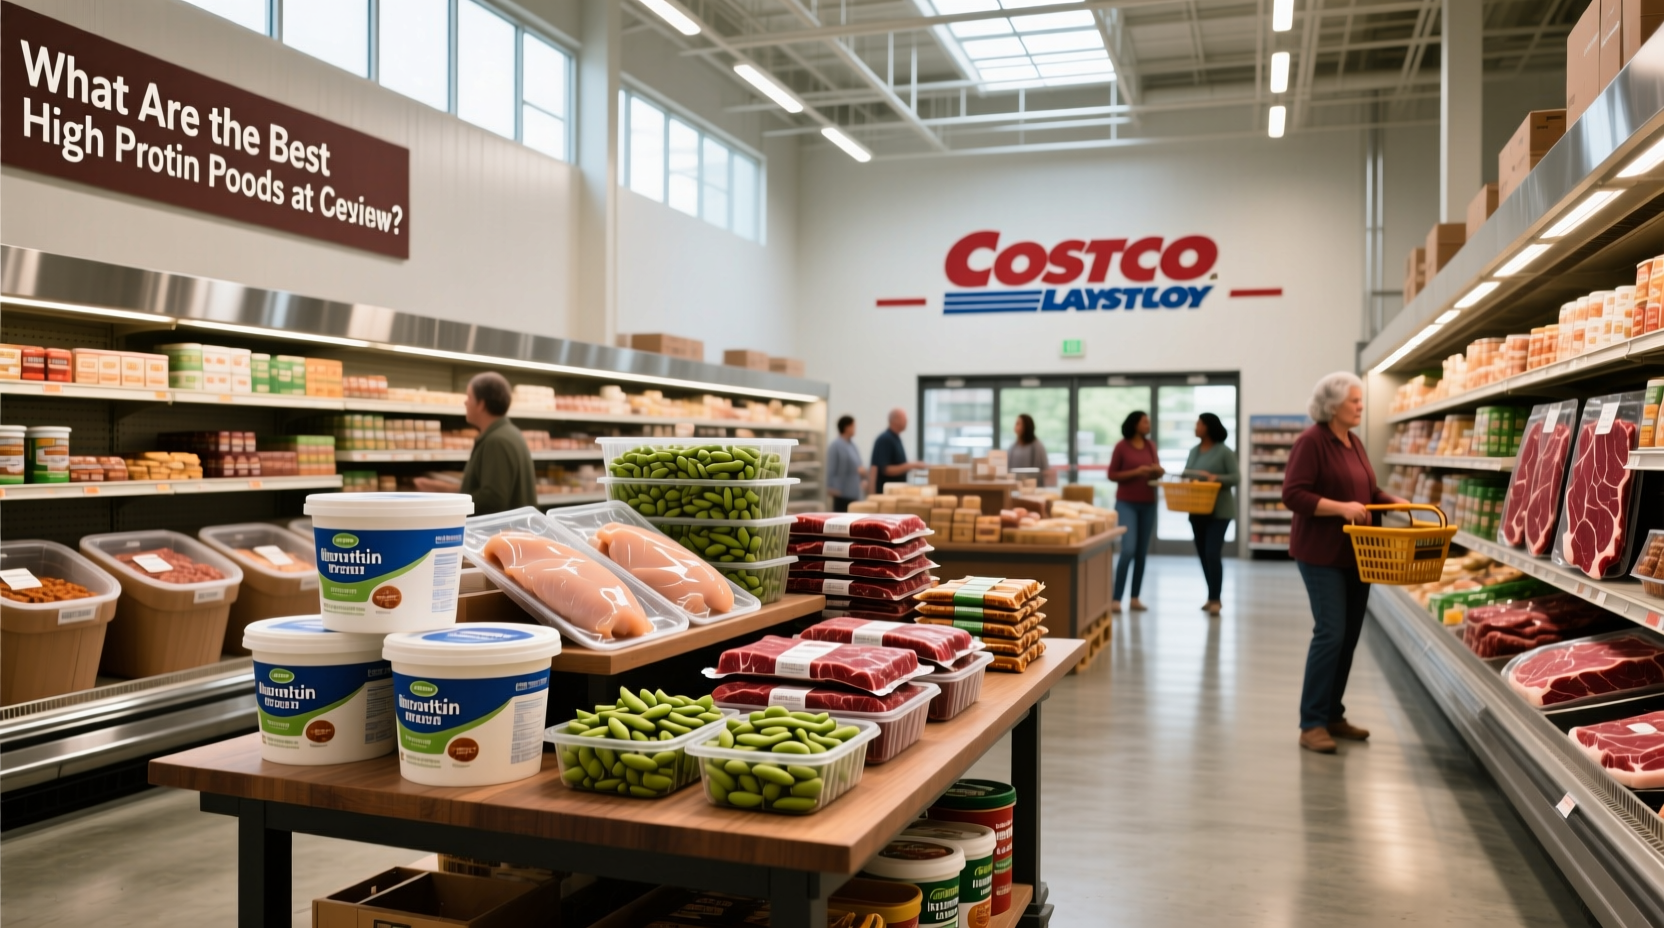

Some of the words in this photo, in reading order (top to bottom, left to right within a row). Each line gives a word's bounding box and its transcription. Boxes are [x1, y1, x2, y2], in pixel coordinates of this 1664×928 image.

[20, 39, 129, 116] What
[137, 82, 200, 137] Are
[208, 106, 260, 156] the
[269, 123, 332, 177] Best
[23, 96, 105, 163] High
[115, 125, 200, 183] Protin
[208, 154, 285, 206] Poods
[291, 184, 314, 213] at
[945, 231, 1218, 287] COSTCO
